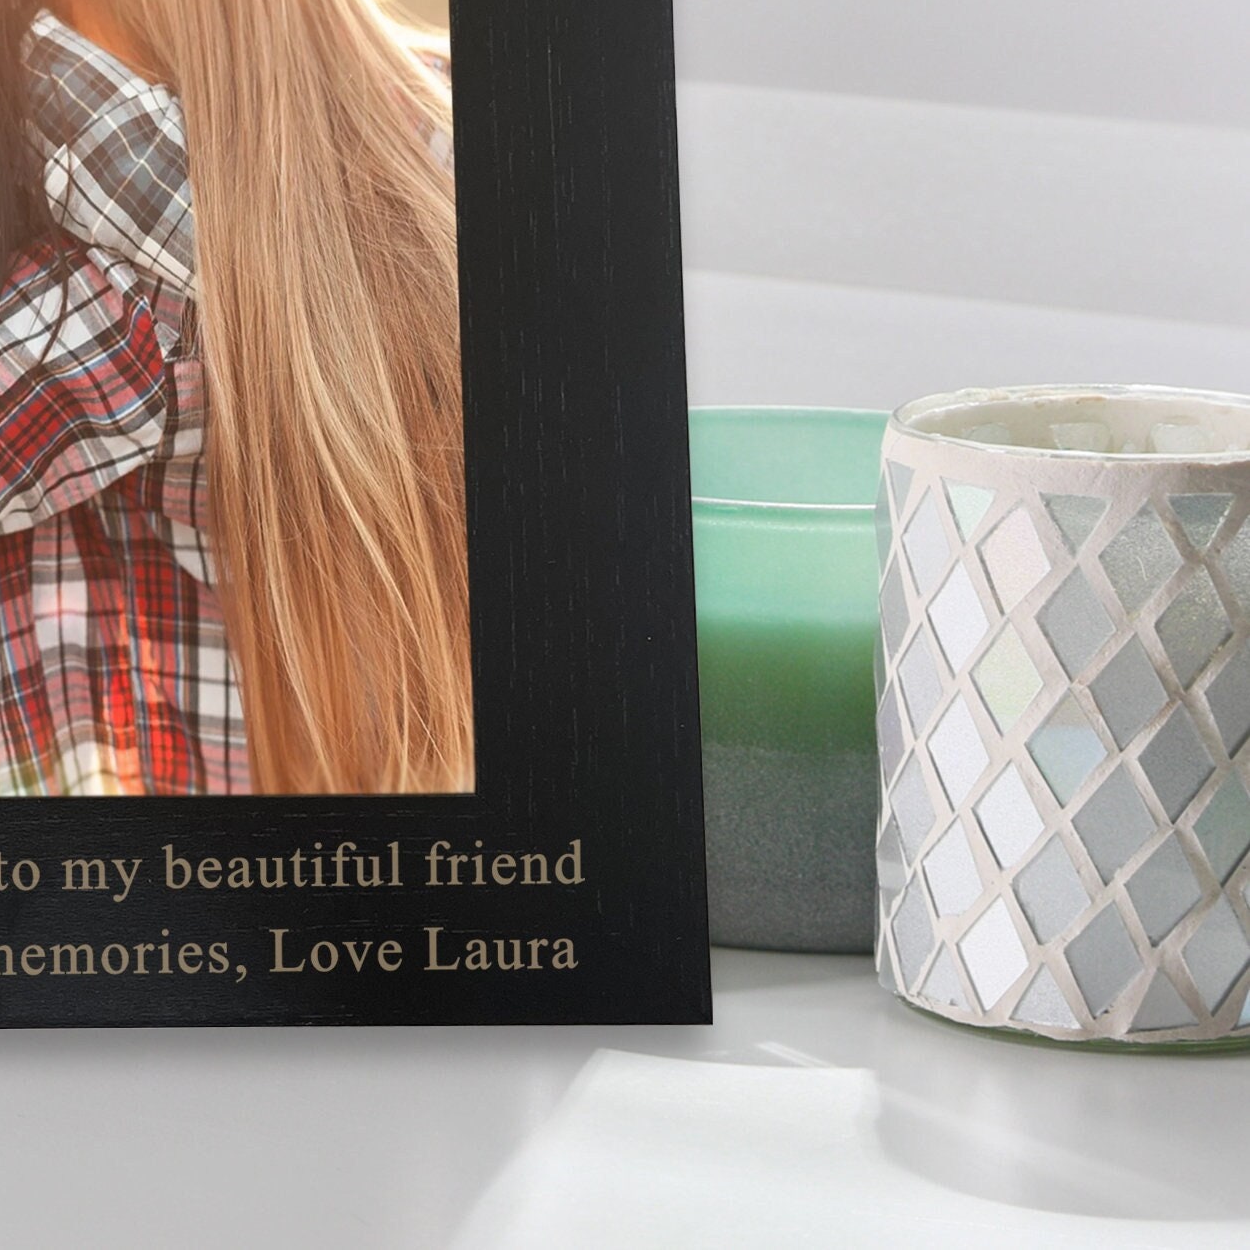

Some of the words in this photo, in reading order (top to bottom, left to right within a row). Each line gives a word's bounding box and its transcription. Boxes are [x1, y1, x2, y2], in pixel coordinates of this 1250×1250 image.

[61, 858, 143, 903] my
[161, 841, 404, 890] beautiful
[424, 839, 587, 886] friend
[268, 928, 403, 973] Love
[423, 927, 579, 971] Laura
